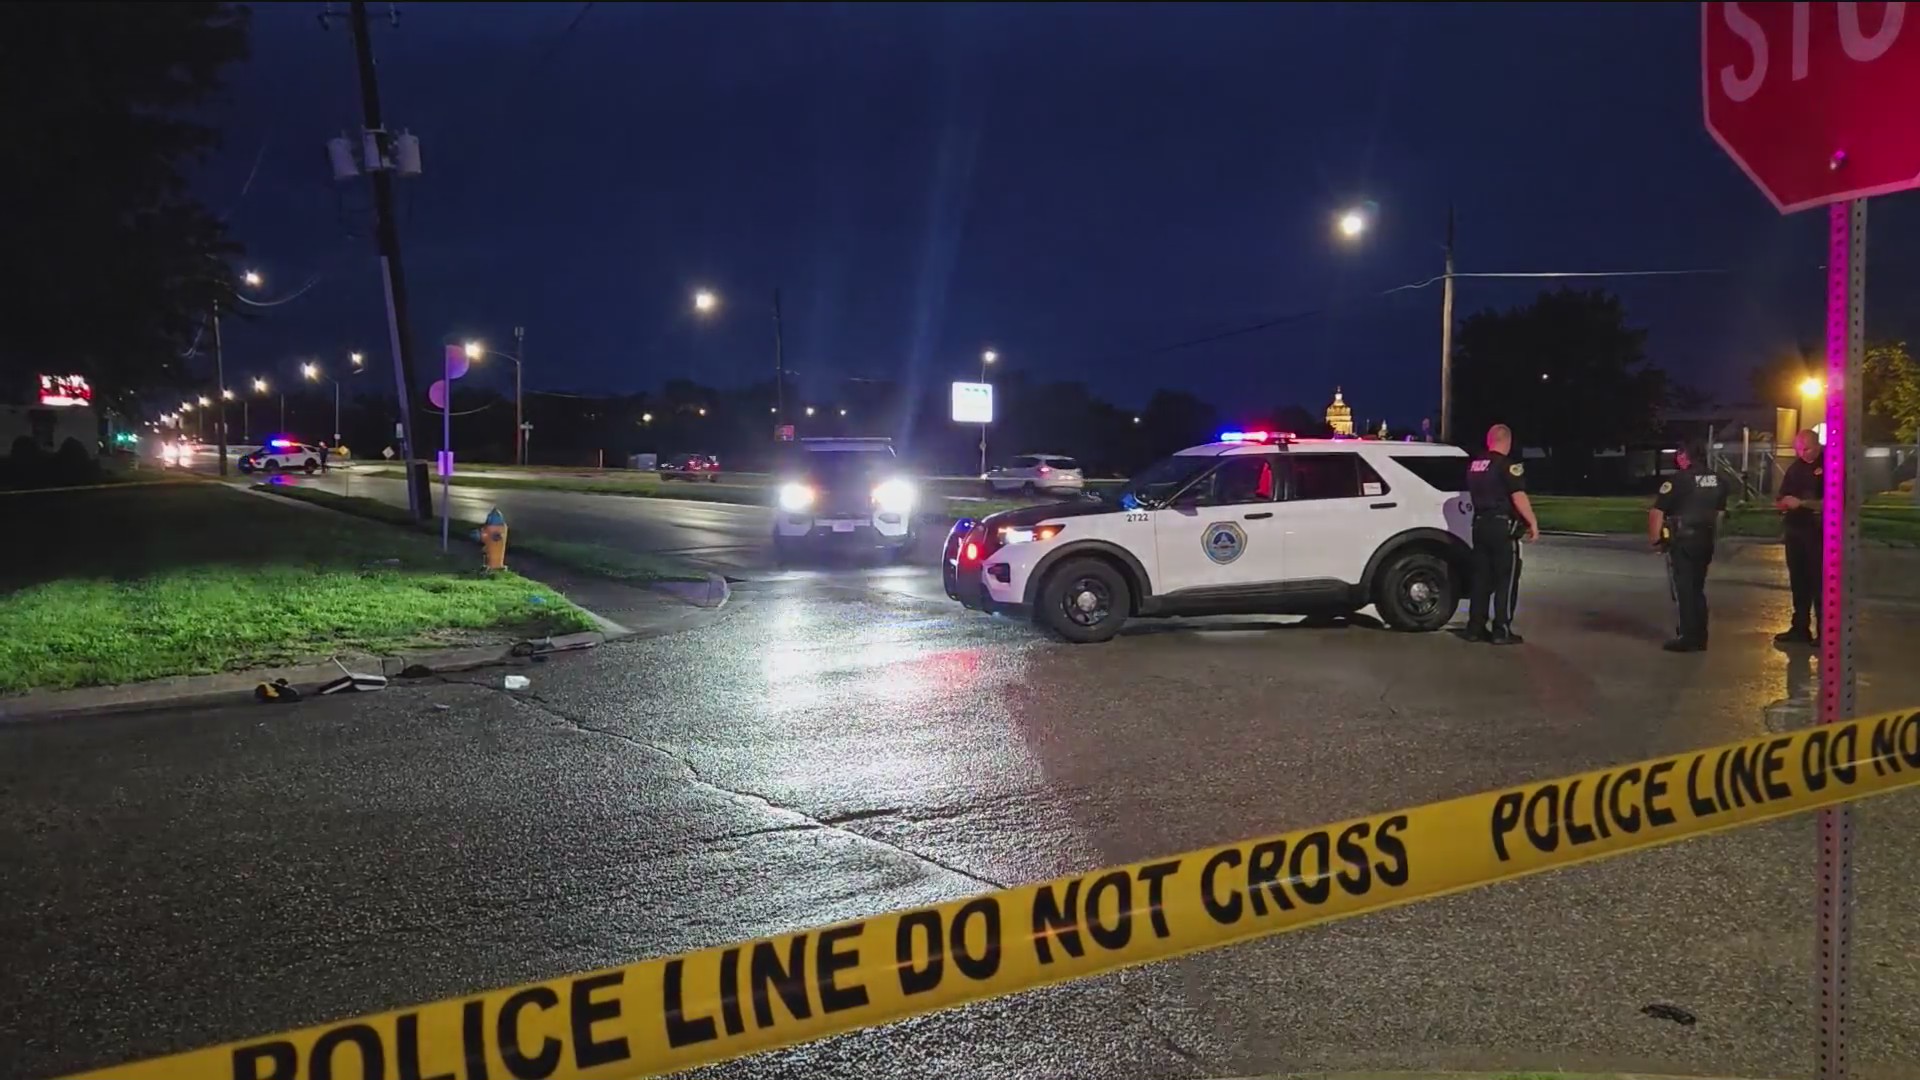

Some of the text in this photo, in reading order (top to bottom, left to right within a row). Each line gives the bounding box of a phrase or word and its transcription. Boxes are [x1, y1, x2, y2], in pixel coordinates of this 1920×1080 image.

[1126, 513, 1149, 522] 2722
[663, 923, 869, 1048] LINE
[896, 898, 1000, 996] DO
[1032, 860, 1182, 964] NOT
[1201, 815, 1408, 925] CROSS
[1491, 760, 1677, 861] POLICE
[1686, 737, 1793, 817] LINE
[1802, 724, 1857, 792] DO
